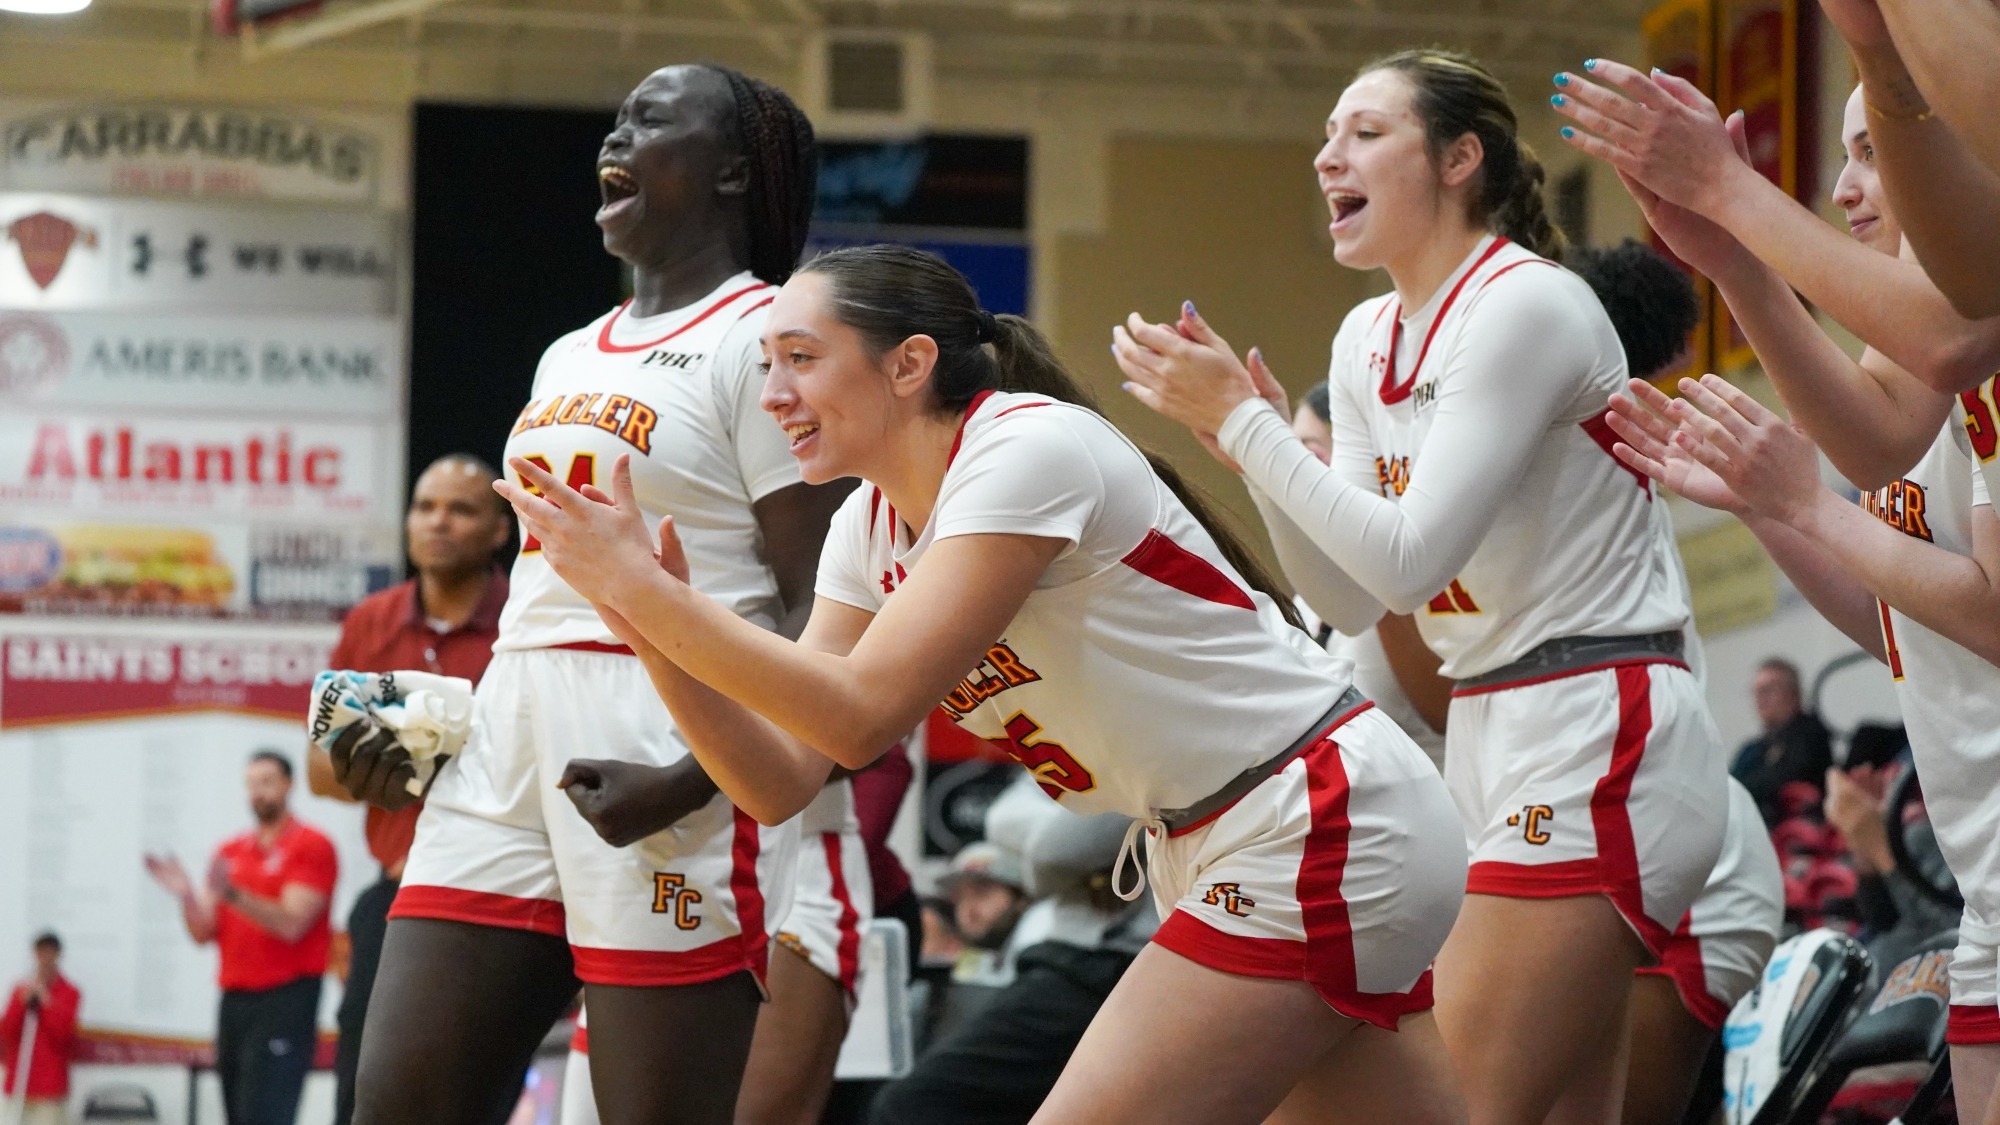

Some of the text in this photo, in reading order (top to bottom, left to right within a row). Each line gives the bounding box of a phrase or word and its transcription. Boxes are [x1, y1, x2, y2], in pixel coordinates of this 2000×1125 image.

[83, 335, 384, 388] AMERIS BANK
[642, 350, 704, 370] PBC
[26, 422, 344, 488] Atlantic
[7, 642, 174, 682] SAINTS
[651, 871, 702, 931] FC
